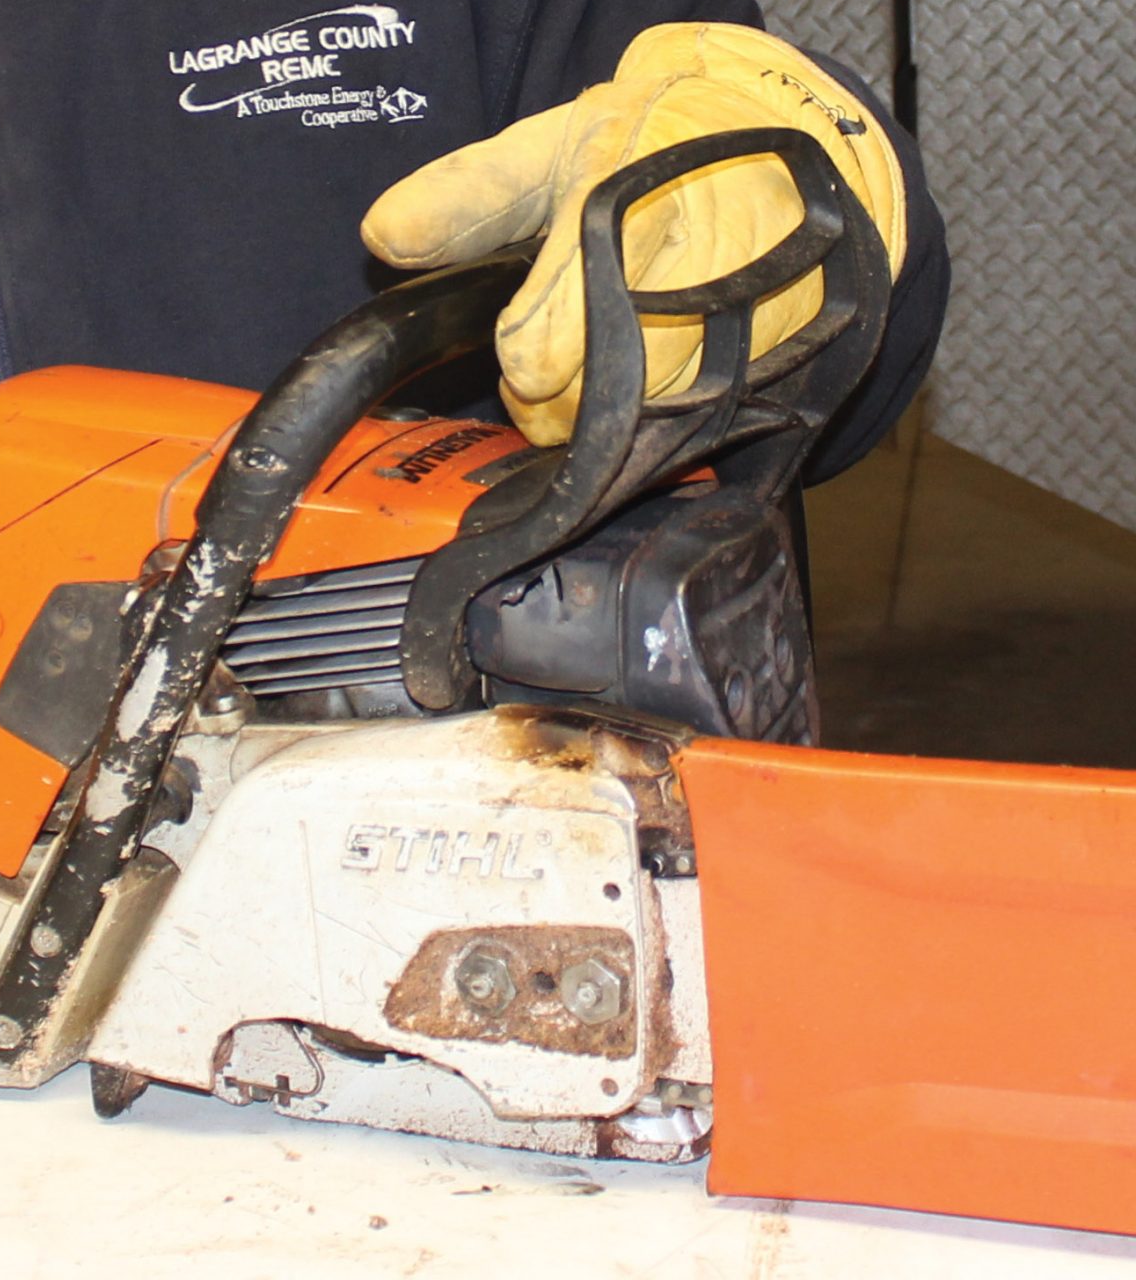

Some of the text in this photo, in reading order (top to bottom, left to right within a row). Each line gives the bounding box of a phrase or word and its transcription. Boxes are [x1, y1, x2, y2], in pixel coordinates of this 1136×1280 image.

[169, 21, 416, 74] LAGRANGE COUNTY
[261, 54, 341, 83] REMC
[237, 86, 374, 118] A Touchstone Energy
[301, 108, 379, 128] Cooperative
[340, 824, 545, 880] STIHL
